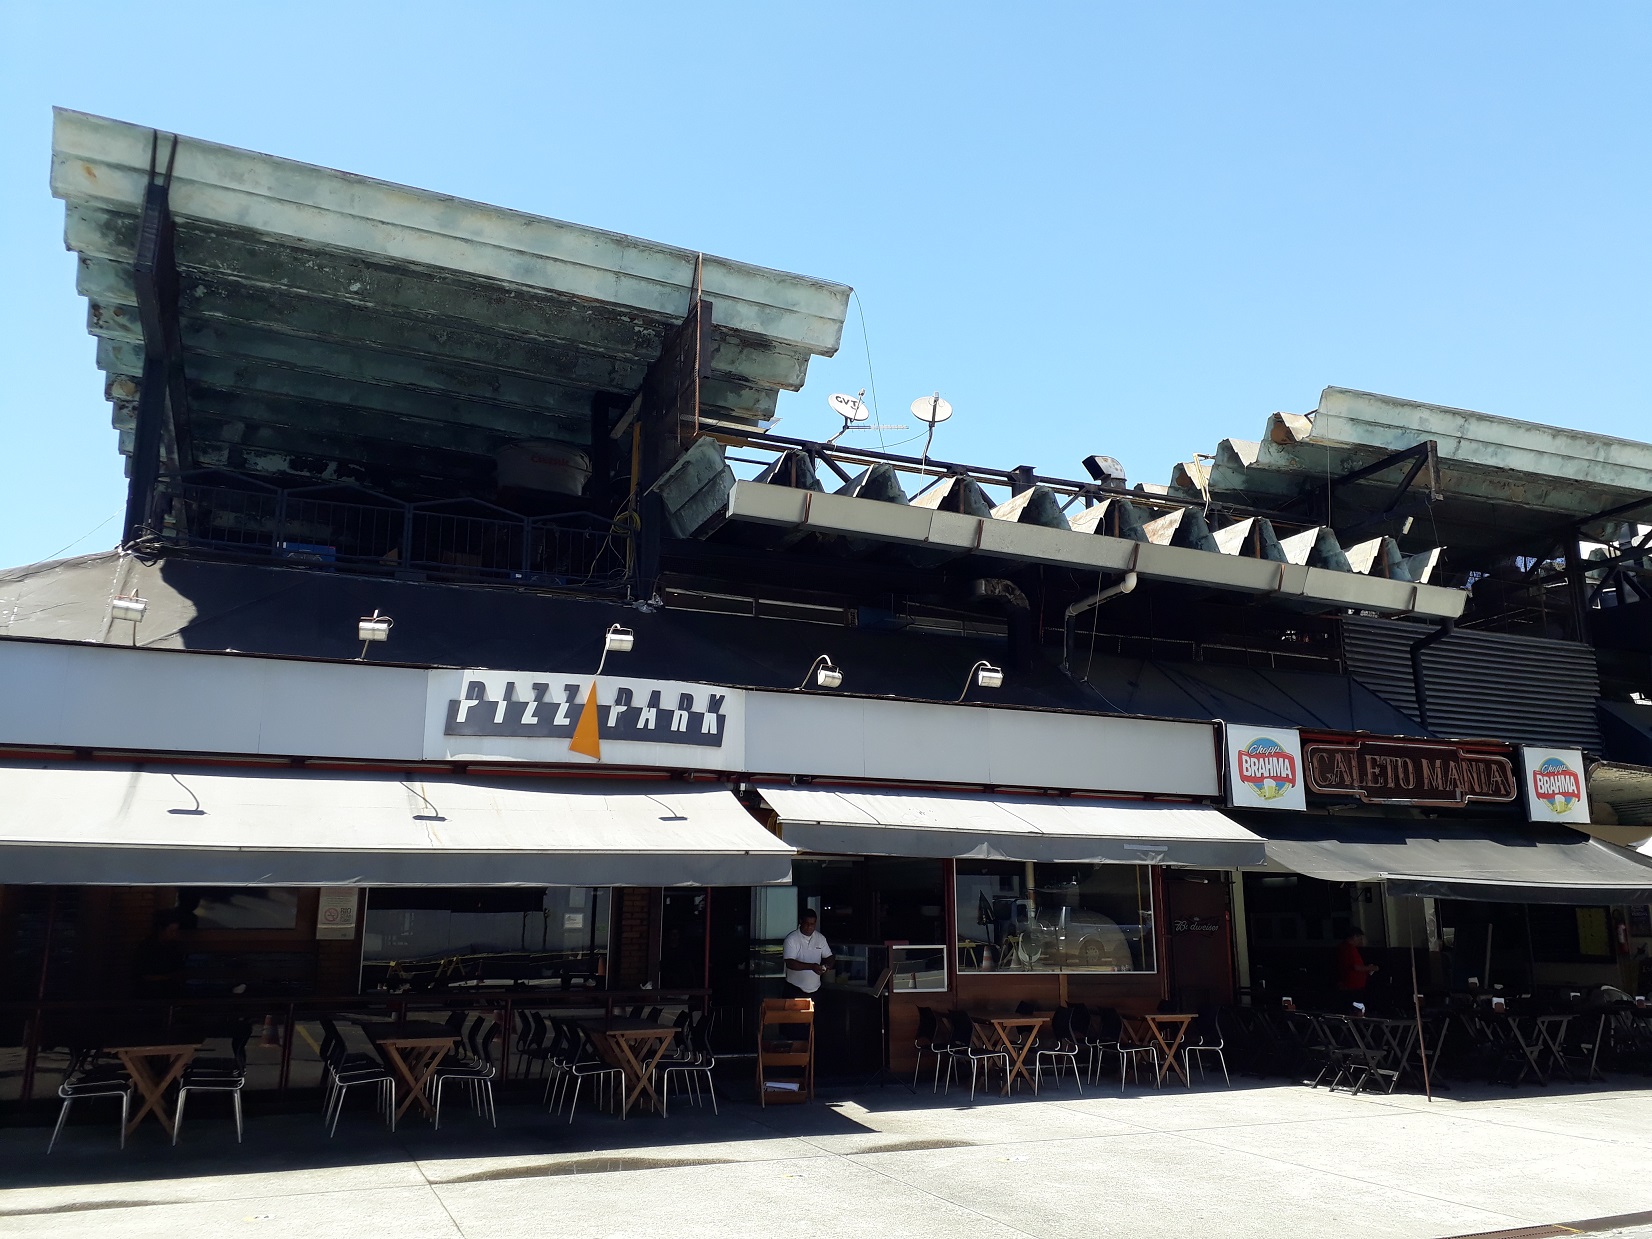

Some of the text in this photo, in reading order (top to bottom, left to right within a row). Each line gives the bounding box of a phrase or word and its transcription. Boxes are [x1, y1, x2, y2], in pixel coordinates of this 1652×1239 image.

[606, 687, 726, 734] PARK
[1248, 744, 1280, 756] Chopp
[1241, 754, 1293, 779] BRAHMA
[1420, 758, 1511, 795] MANIA
[1536, 774, 1578, 795] BRAHMA
